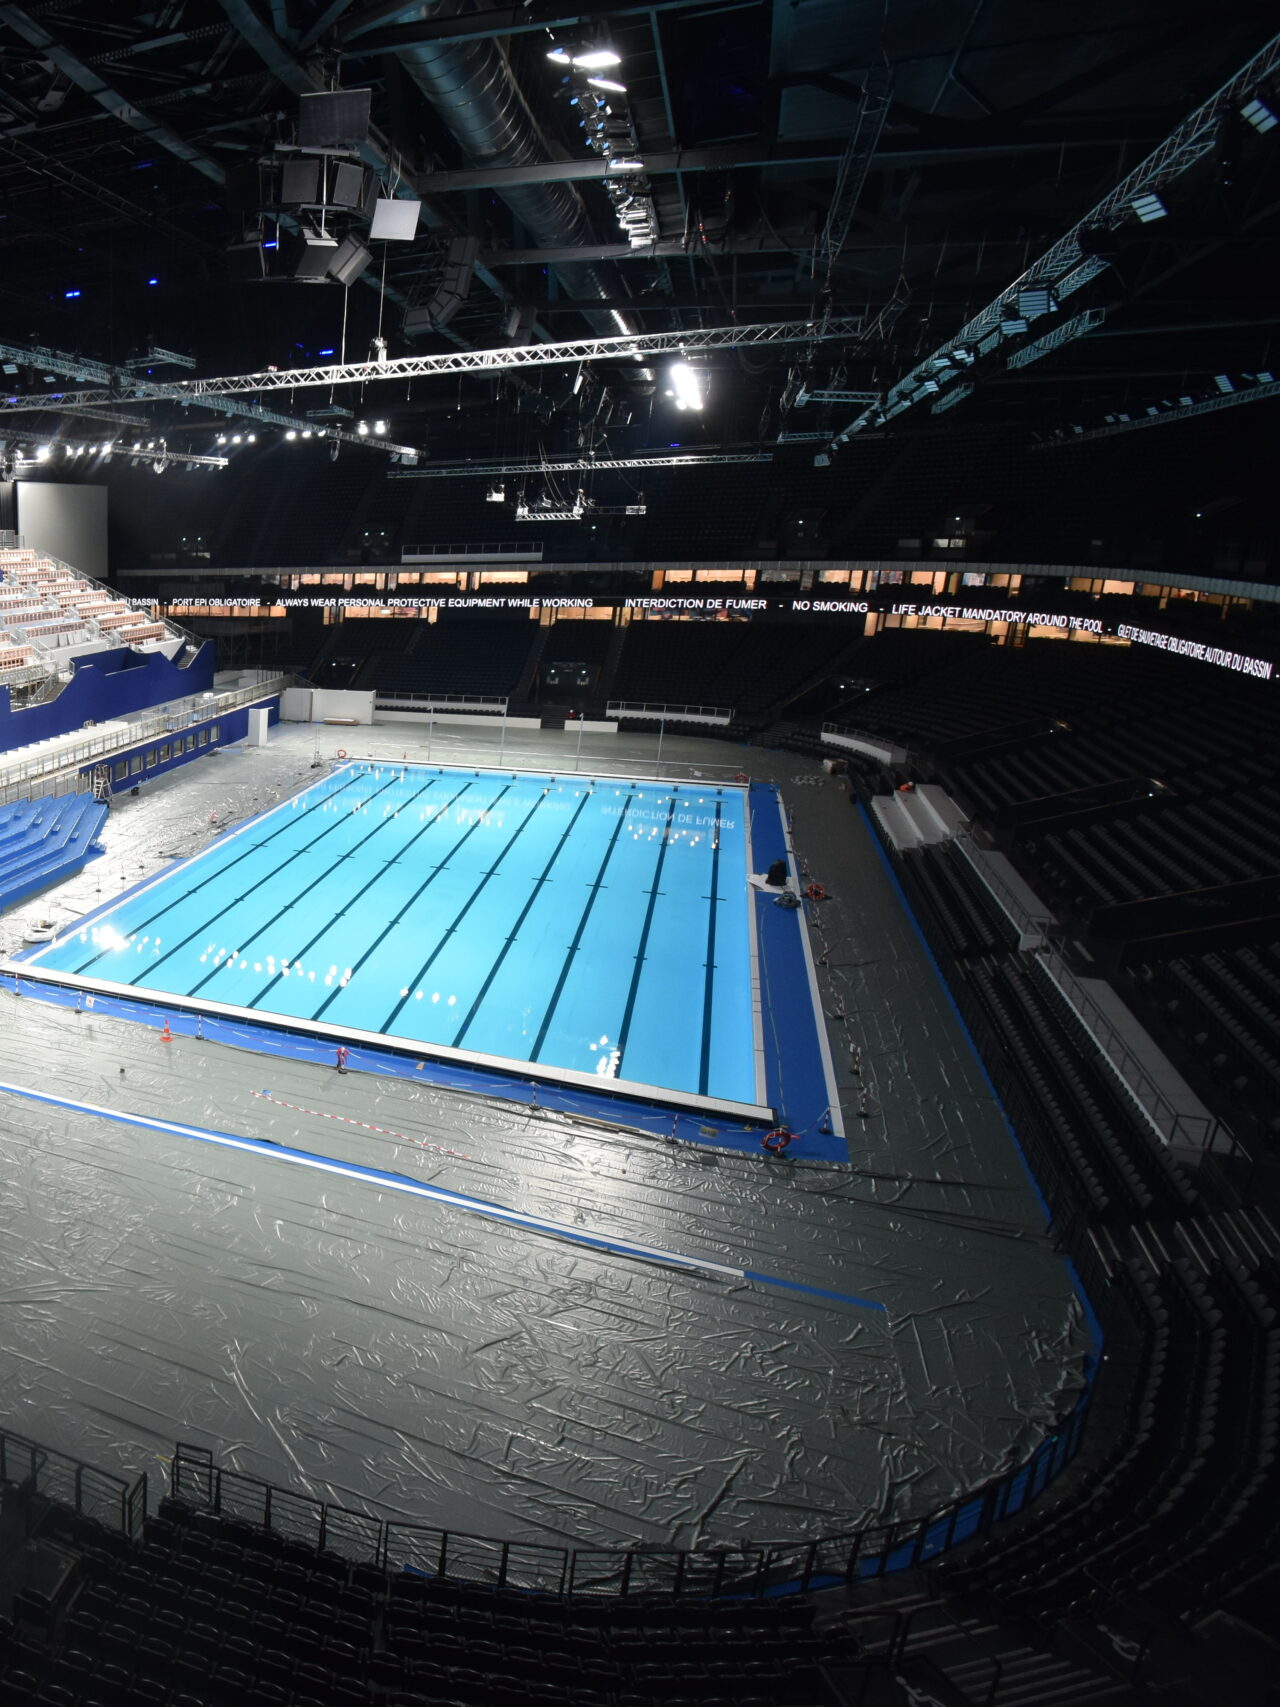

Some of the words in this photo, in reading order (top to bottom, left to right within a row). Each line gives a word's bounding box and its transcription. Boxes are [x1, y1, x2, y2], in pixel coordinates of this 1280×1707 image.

[132, 598, 159, 606] BASSIN
[172, 598, 194, 606] PORT
[195, 598, 207, 606] EPI
[208, 598, 261, 606] OBLIGATOIRE
[275, 598, 309, 607] ALWAYS
[310, 598, 337, 607] WEAR
[339, 598, 386, 607] PERSONAL
[387, 598, 446, 608] PROTECTIVE
[448, 598, 506, 608] EQUIPMENT
[508, 598, 540, 608] WHILE
[541, 598, 593, 608] WORKING
[624, 598, 704, 609] INTERDICTION
[706, 599, 723, 609] DE
[725, 599, 767, 610] FUMER
[792, 600, 810, 611] NO
[812, 601, 869, 613] SMOKING
[891, 604, 917, 615] LIFE
[918, 605, 961, 618] JACKET
[963, 608, 1026, 623] MANDATORY
[1026, 612, 1067, 628] AROUND
[1069, 616, 1083, 630] THE
[1083, 619, 1103, 633] POOL
[1130, 626, 1139, 641] DE
[1138, 628, 1169, 650] SAUVETAGE
[1168, 637, 1206, 661] OBLIGATOIRE
[1205, 646, 1233, 668] AUTOUR
[1231, 653, 1245, 671] DU
[1243, 656, 1272, 680] BASSIN
